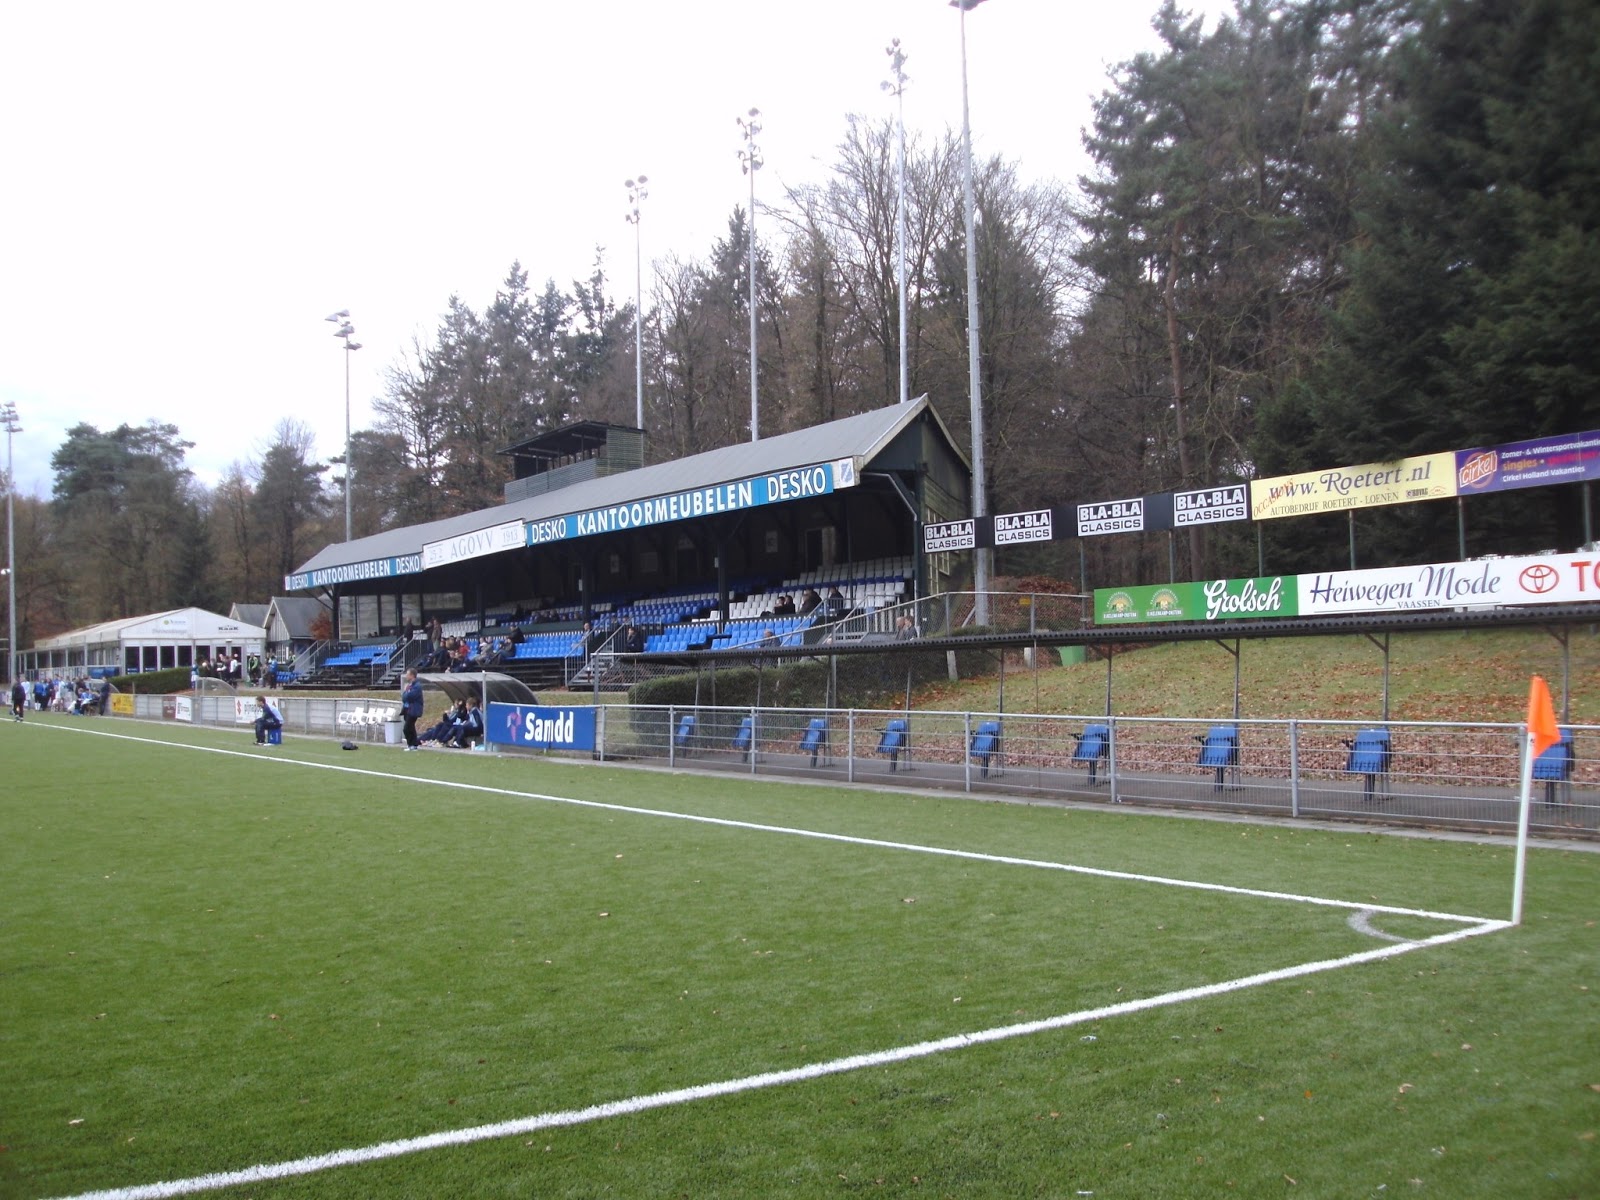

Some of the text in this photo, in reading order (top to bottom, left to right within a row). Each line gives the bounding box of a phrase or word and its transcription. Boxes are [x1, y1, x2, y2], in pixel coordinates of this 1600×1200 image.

[1532, 439, 1600, 454] Wintersportvakanti
[1503, 459, 1538, 471] singles
[1522, 469, 1550, 479] Holland
[1550, 466, 1586, 476] Vakanties
[531, 466, 827, 544] DESKO KANTOORMEUBELEN DESKO
[1322, 496, 1358, 510] ROETERT
[1365, 491, 1400, 504] LOENEN
[1177, 506, 1245, 523] CLASSICS
[1080, 518, 1141, 533] CLASSICS
[926, 536, 973, 550] CLASSICS
[996, 528, 1050, 542] CLASSICS
[450, 529, 494, 560] AGOVV
[502, 528, 519, 544] 1913
[292, 554, 420, 590] DESKO KANTOORMEUBELEN DESKO
[1309, 562, 1501, 606] Heiwegen Mode
[1203, 576, 1282, 620] Grolsch
[1397, 599, 1441, 609] VAASSEN
[524, 710, 575, 744] Sandd
